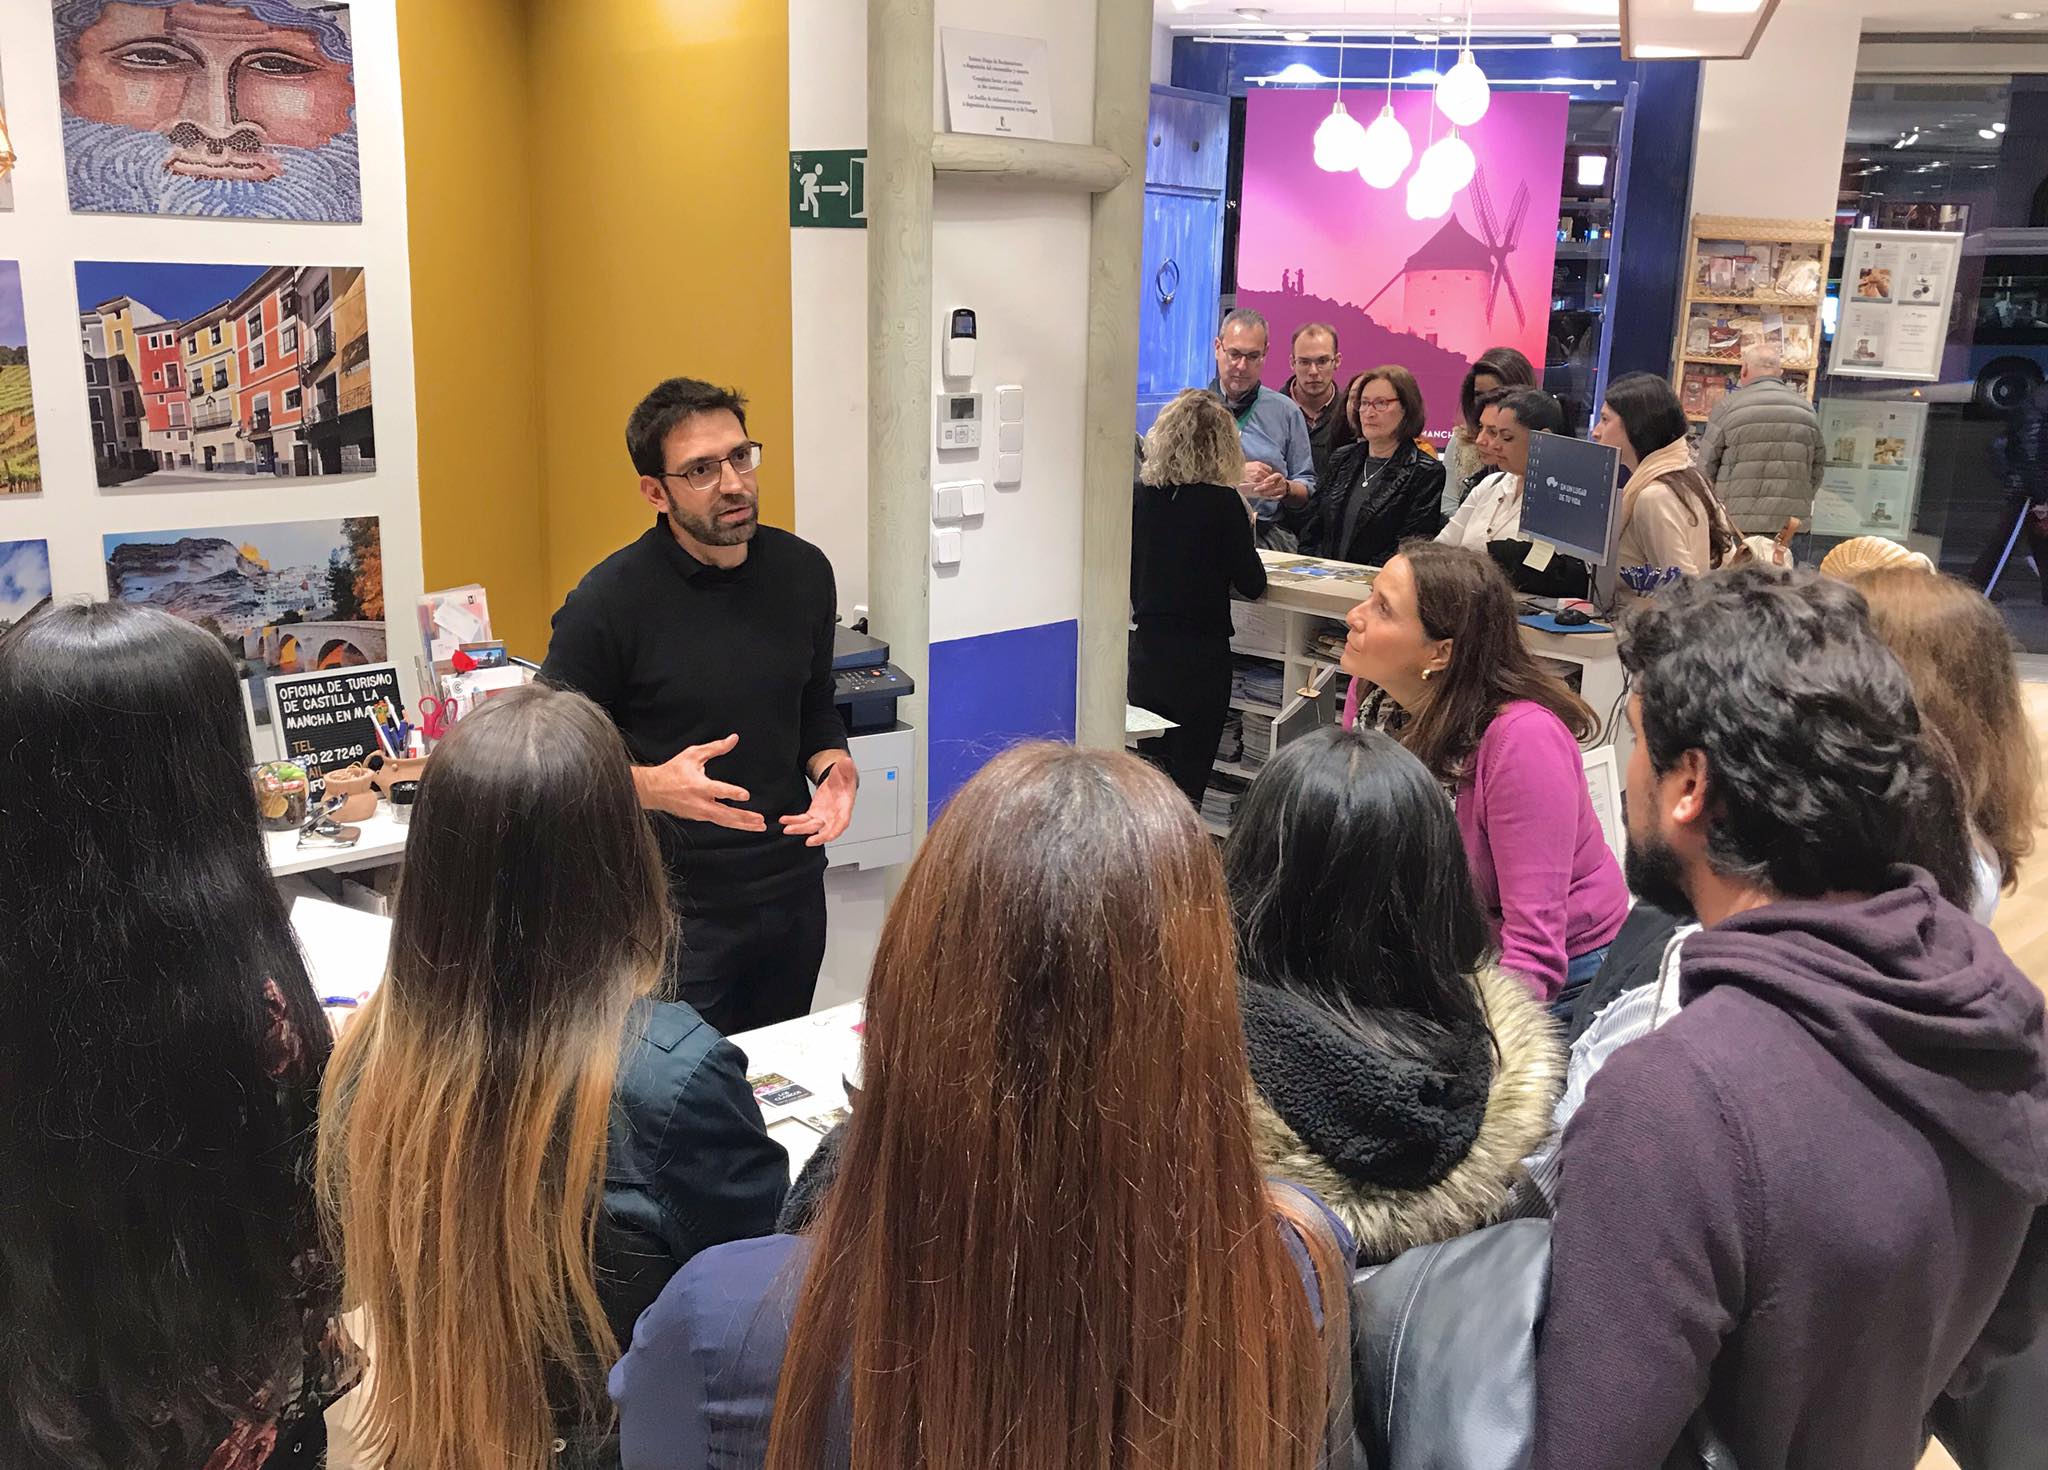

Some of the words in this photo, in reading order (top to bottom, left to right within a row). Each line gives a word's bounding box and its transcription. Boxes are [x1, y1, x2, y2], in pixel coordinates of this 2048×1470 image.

[1421, 430, 1454, 439] MANCH
[280, 683, 325, 700] OFICINA
[327, 680, 342, 693] DE
[346, 673, 392, 690] TURISMO
[283, 700, 299, 713] DE
[303, 692, 355, 711] CASTILLA
[362, 689, 379, 702] LA
[286, 712, 333, 729] MANCHA
[336, 709, 351, 723] EN
[292, 740, 315, 753] TEL
[296, 752, 318, 766] 30
